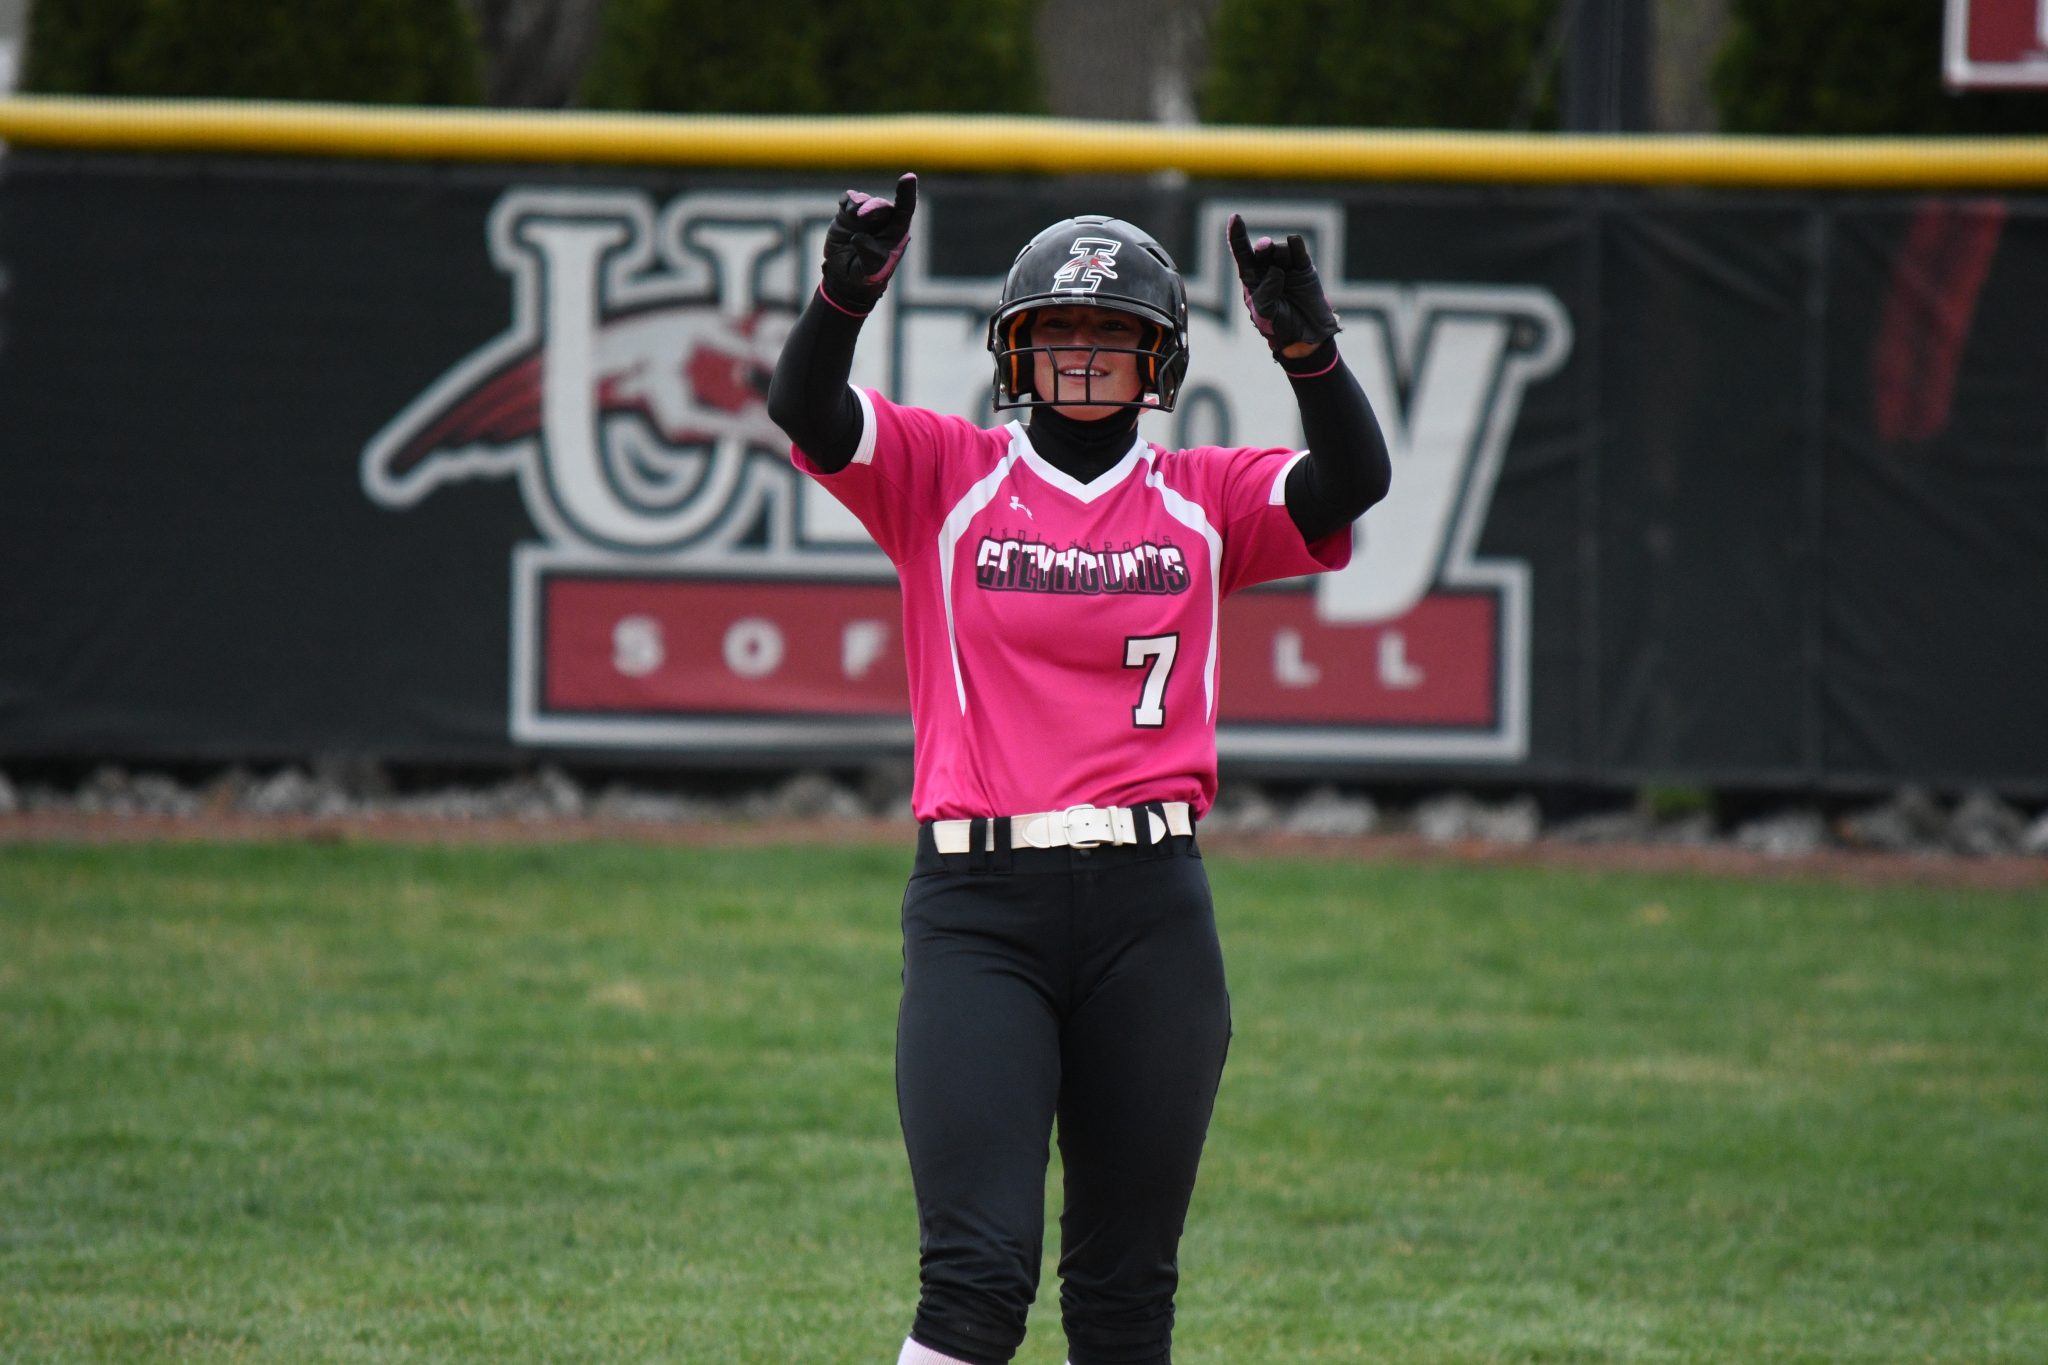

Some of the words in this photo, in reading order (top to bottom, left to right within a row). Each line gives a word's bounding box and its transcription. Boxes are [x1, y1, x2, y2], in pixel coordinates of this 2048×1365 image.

[975, 535, 1191, 596] GREYHOUNDS
[611, 614, 1424, 690] SOFLL
[1122, 632, 1180, 729] 7
